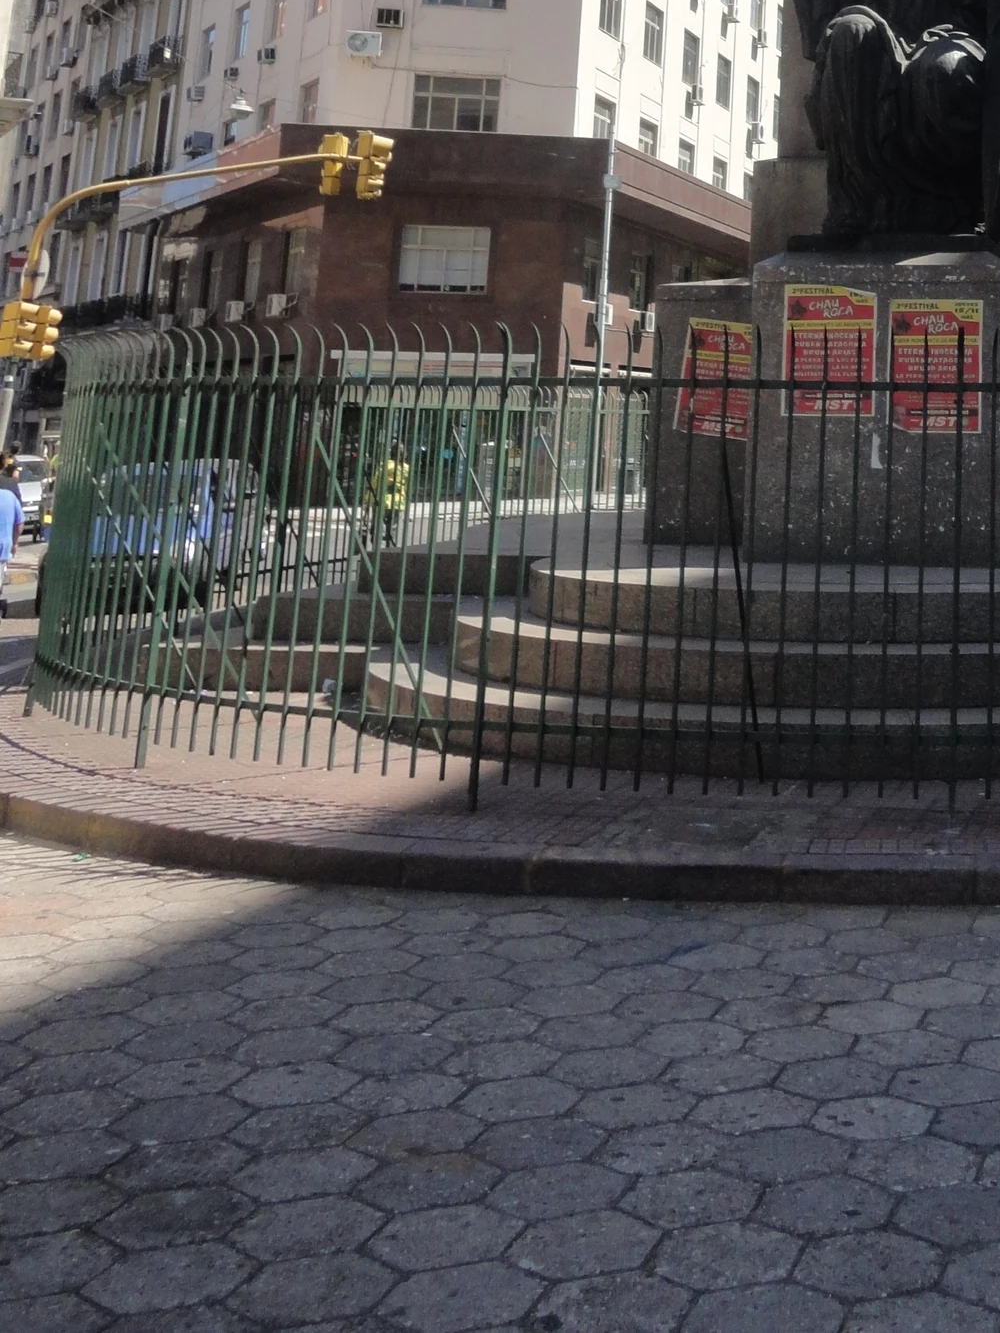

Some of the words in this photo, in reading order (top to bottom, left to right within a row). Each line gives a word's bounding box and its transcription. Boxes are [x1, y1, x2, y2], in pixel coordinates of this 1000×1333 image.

[808, 299, 840, 311] CHAU
[823, 305, 853, 318] ROCA
[913, 314, 944, 326] CHAU
[928, 322, 959, 334] ROCA
[814, 399, 853, 410] MST
[920, 416, 957, 427] MST
